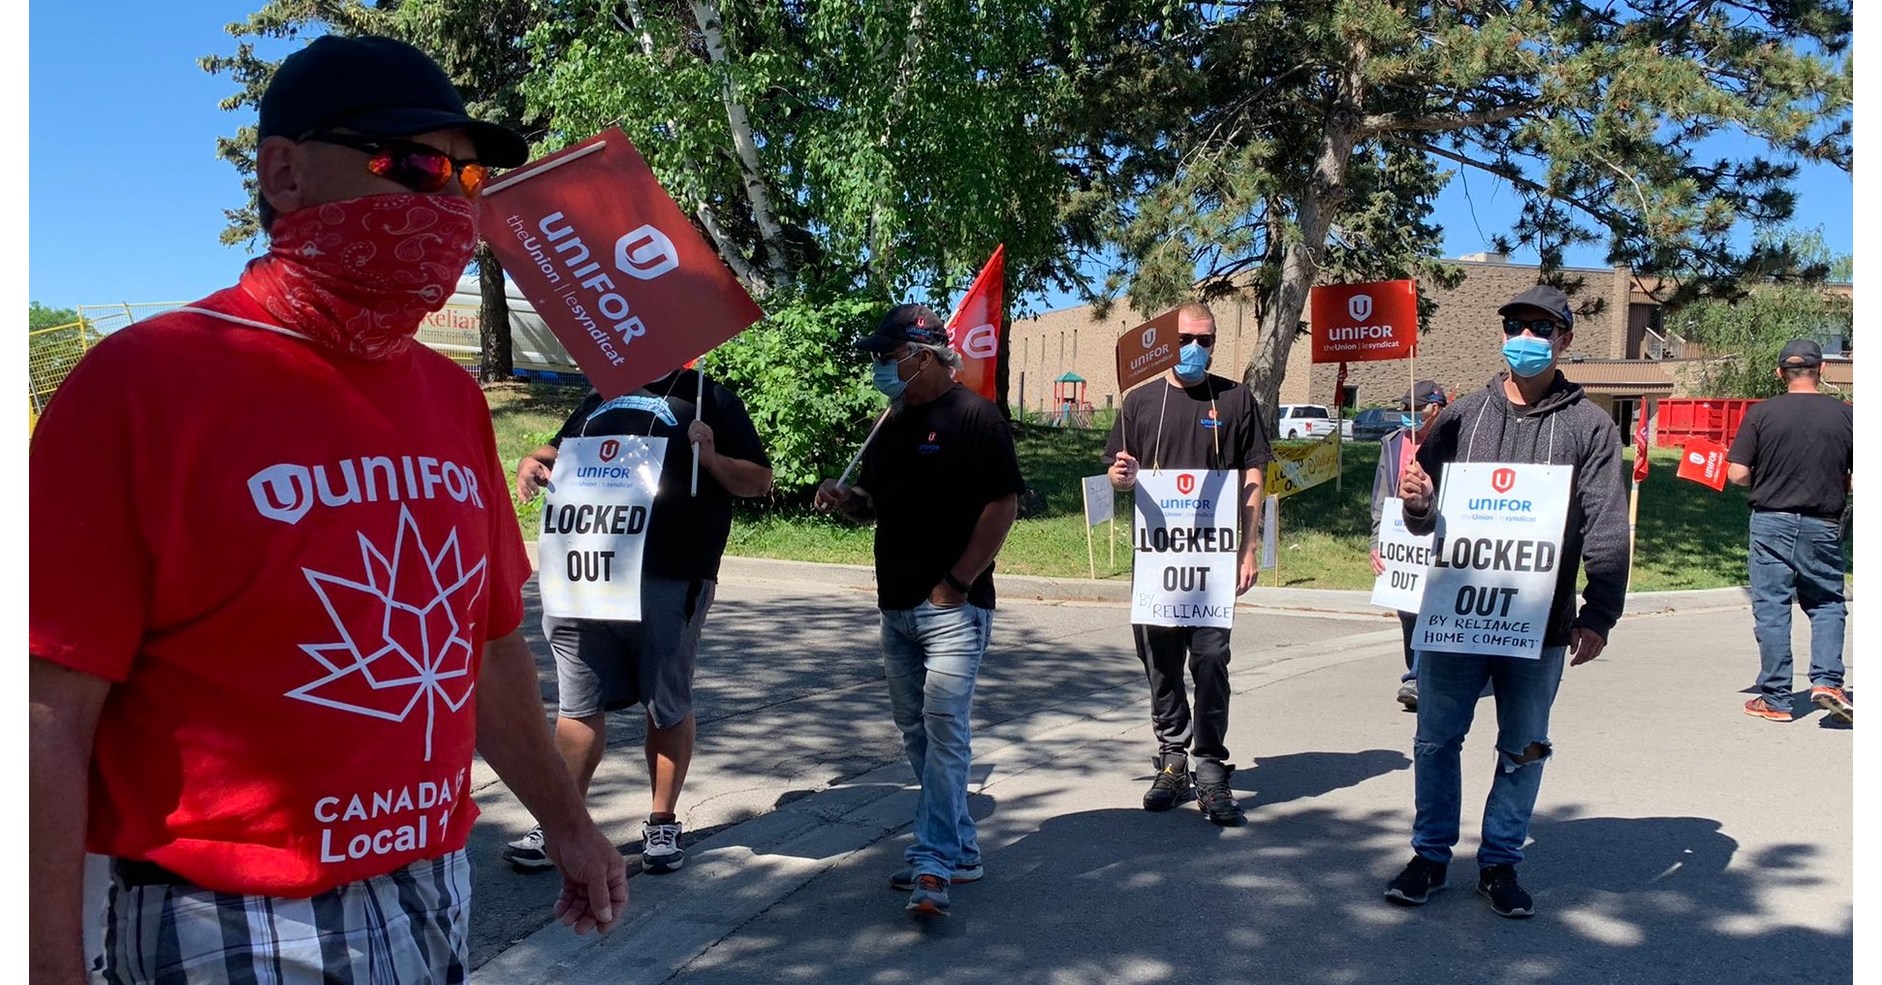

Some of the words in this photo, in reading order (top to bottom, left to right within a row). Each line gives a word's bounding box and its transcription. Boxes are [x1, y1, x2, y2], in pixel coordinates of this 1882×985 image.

[506, 214, 561, 284] theUnion
[563, 291, 625, 367] lesyndicat
[544, 504, 647, 535] LOCKED
[1140, 527, 1234, 553] LOCKED
[567, 549, 615, 582] OUT
[1434, 537, 1557, 573] LOCKED
[1163, 566, 1211, 592] OUT
[1390, 570, 1419, 592] OUT
[1139, 593, 1157, 608] BY
[1153, 603, 1233, 620] RELIANCE
[1454, 584, 1519, 618] OUT
[1429, 615, 1448, 627] BY
[1455, 617, 1531, 633] RELIANCE
[1424, 630, 1465, 644] HOME
[1472, 634, 1539, 649] COMFORT
[314, 777, 452, 824] CANADA
[320, 815, 427, 863] Local
